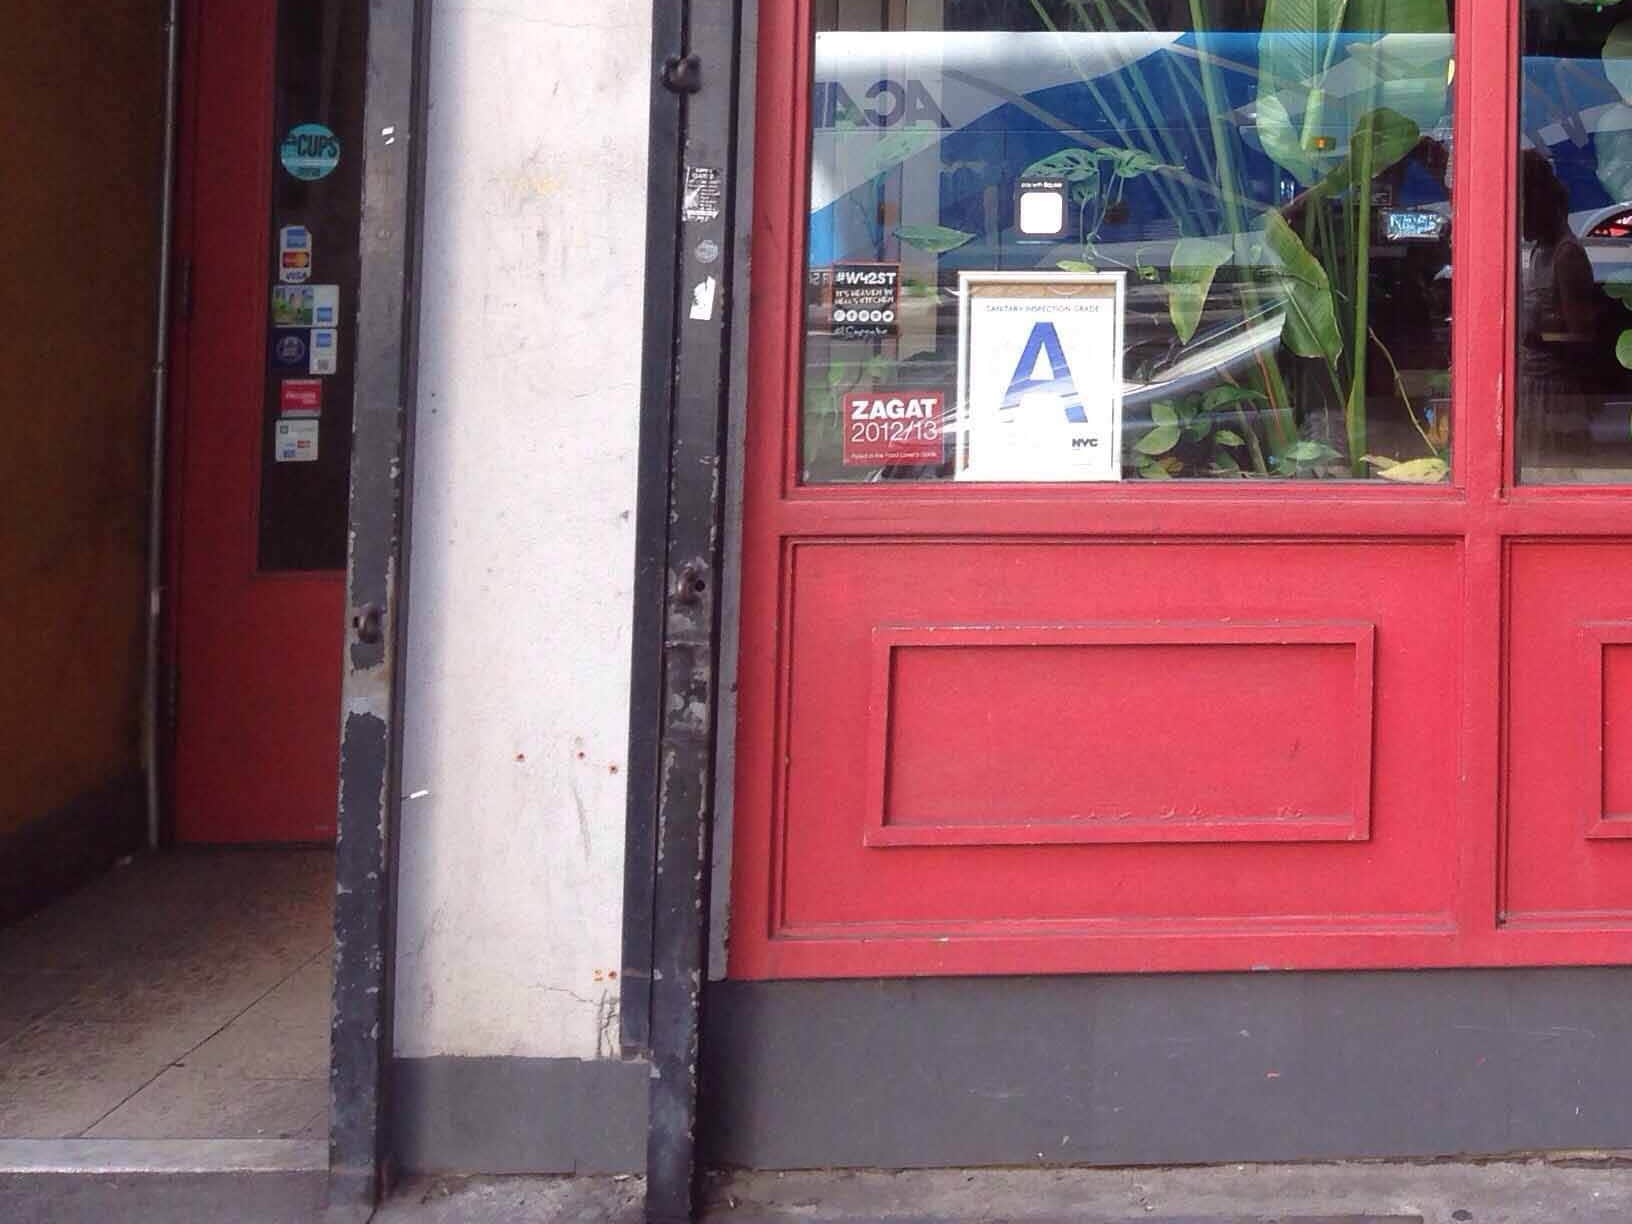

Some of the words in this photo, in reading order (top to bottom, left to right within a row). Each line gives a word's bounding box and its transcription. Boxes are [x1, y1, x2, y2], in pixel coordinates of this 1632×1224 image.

[836, 271, 897, 285] #W42ST
[999, 321, 1089, 424] A
[851, 398, 938, 420] ZAGAT
[851, 420, 939, 443] 2012/13
[1071, 437, 1099, 448] NYC
